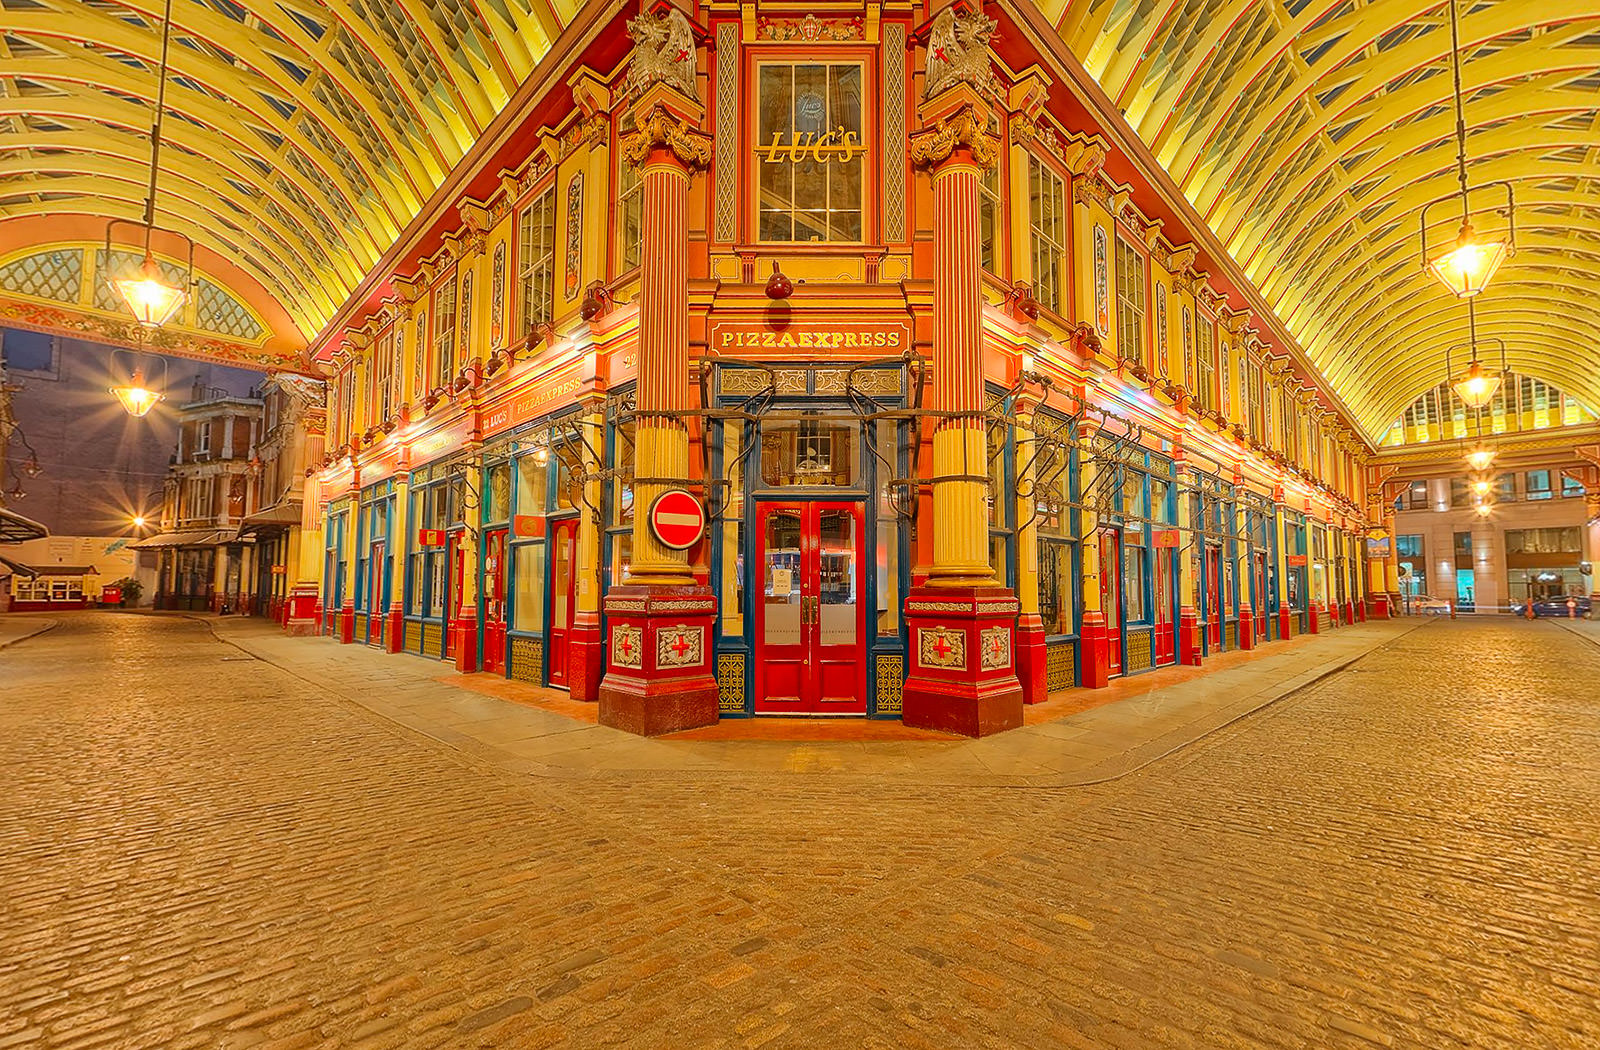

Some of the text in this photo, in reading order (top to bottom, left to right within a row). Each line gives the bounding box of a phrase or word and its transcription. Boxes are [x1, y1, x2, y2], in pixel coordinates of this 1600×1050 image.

[765, 126, 857, 163] LUC'S
[721, 332, 900, 348] PIZZAEXPRESS
[517, 377, 582, 414] PIZZAEXPRESS
